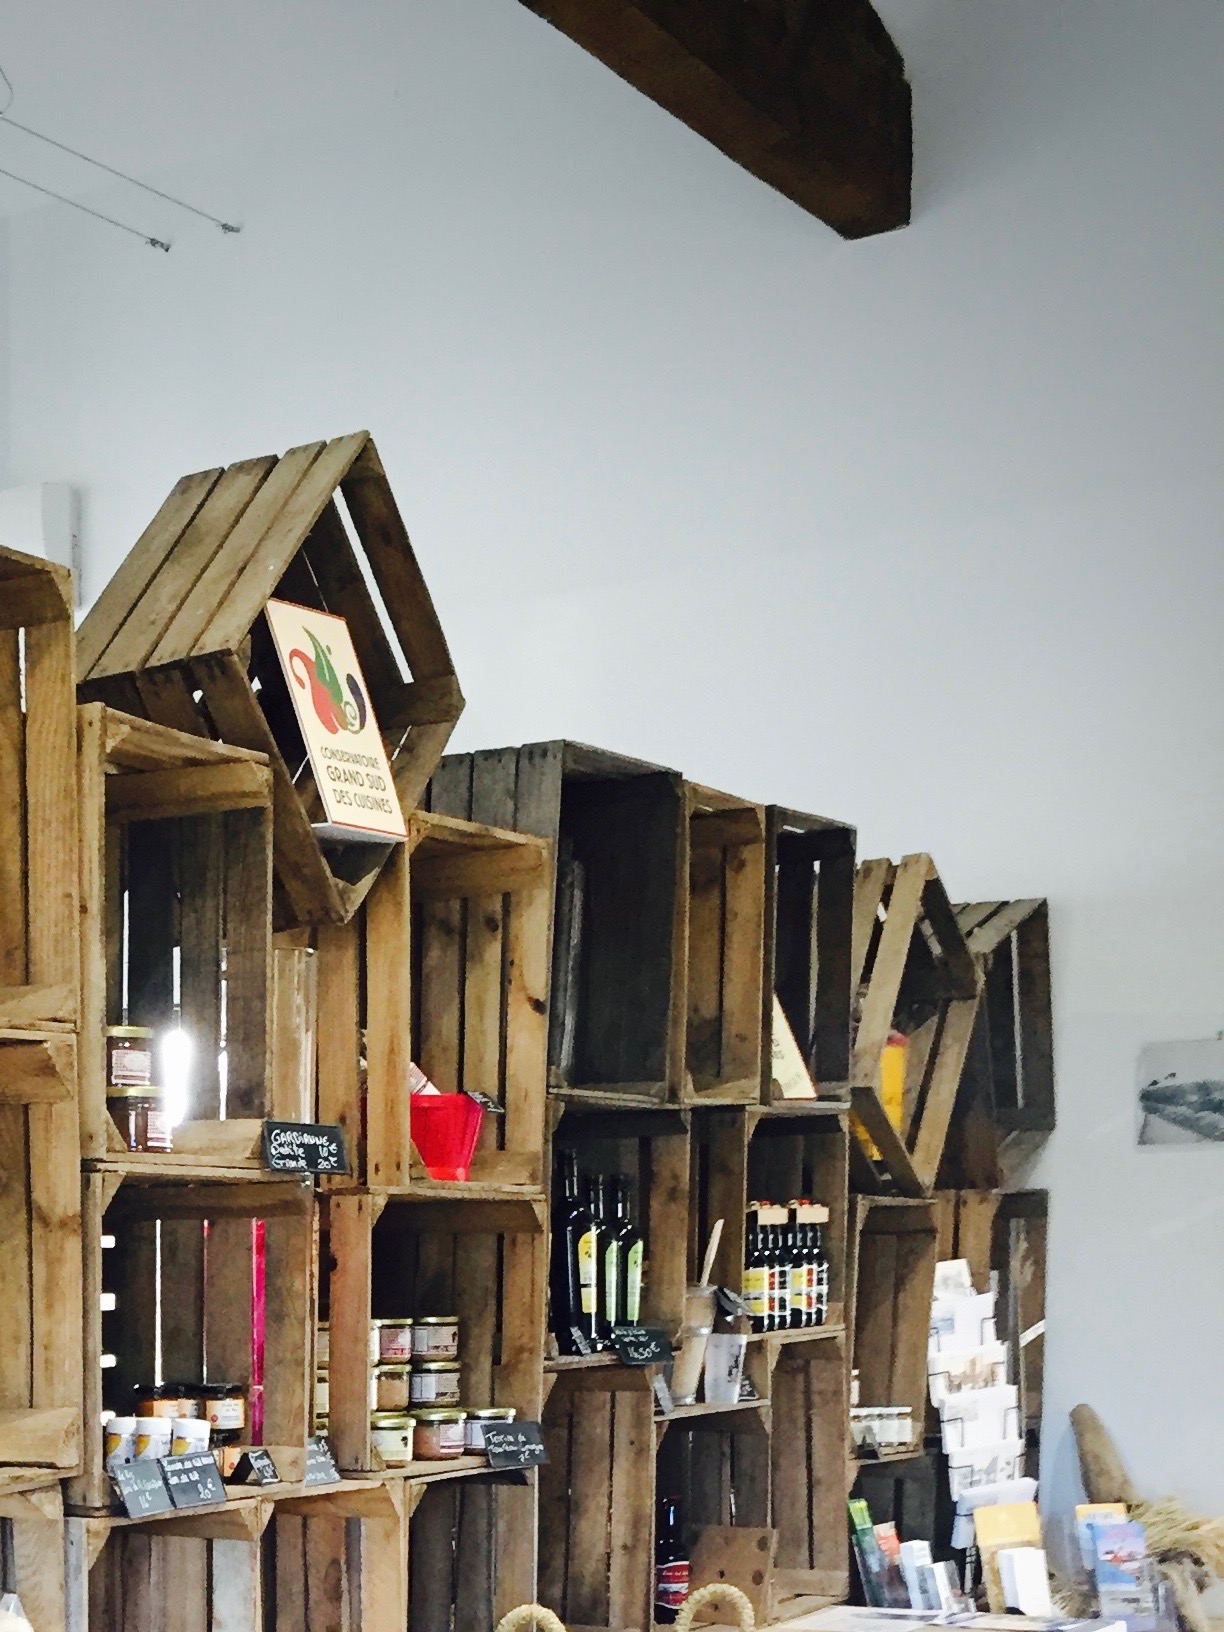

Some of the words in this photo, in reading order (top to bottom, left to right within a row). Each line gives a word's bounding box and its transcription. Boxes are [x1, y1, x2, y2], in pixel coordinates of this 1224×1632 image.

[326, 765, 365, 787] GRAND
[366, 773, 387, 791] SUD
[332, 789, 353, 806] DES
[354, 793, 393, 814] CUISINES
